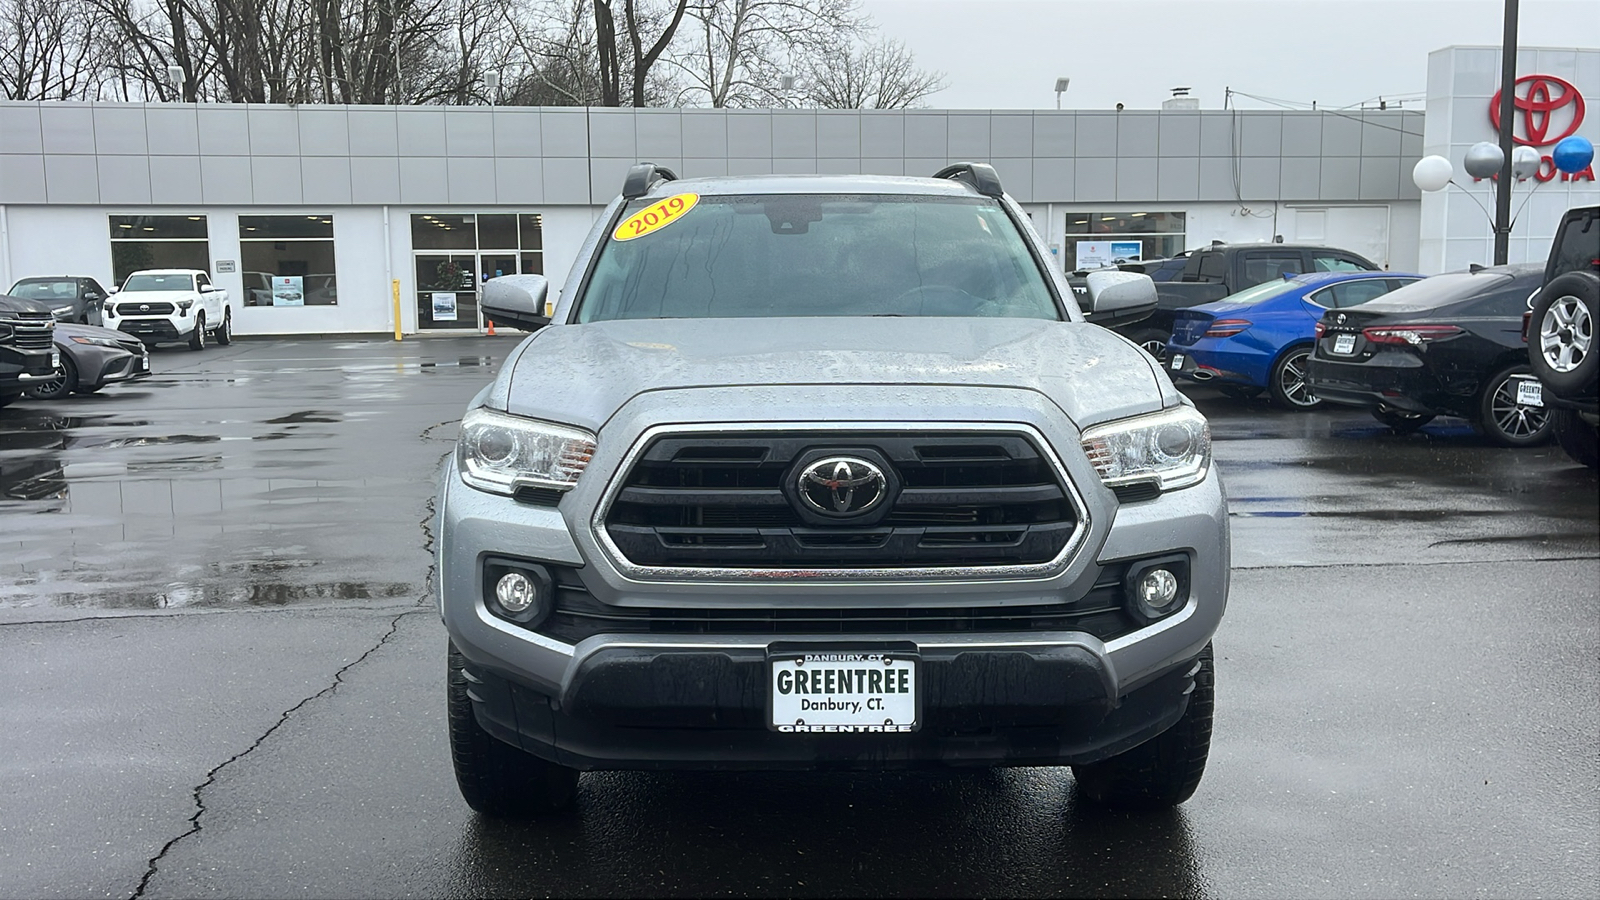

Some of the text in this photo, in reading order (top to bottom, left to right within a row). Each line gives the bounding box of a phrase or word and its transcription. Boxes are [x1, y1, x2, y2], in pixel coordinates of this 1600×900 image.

[629, 197, 685, 235] 2019
[777, 668, 909, 695] GREENTREE
[801, 697, 885, 714] Danbury, CT.
[778, 725, 912, 733] GREENTREE
